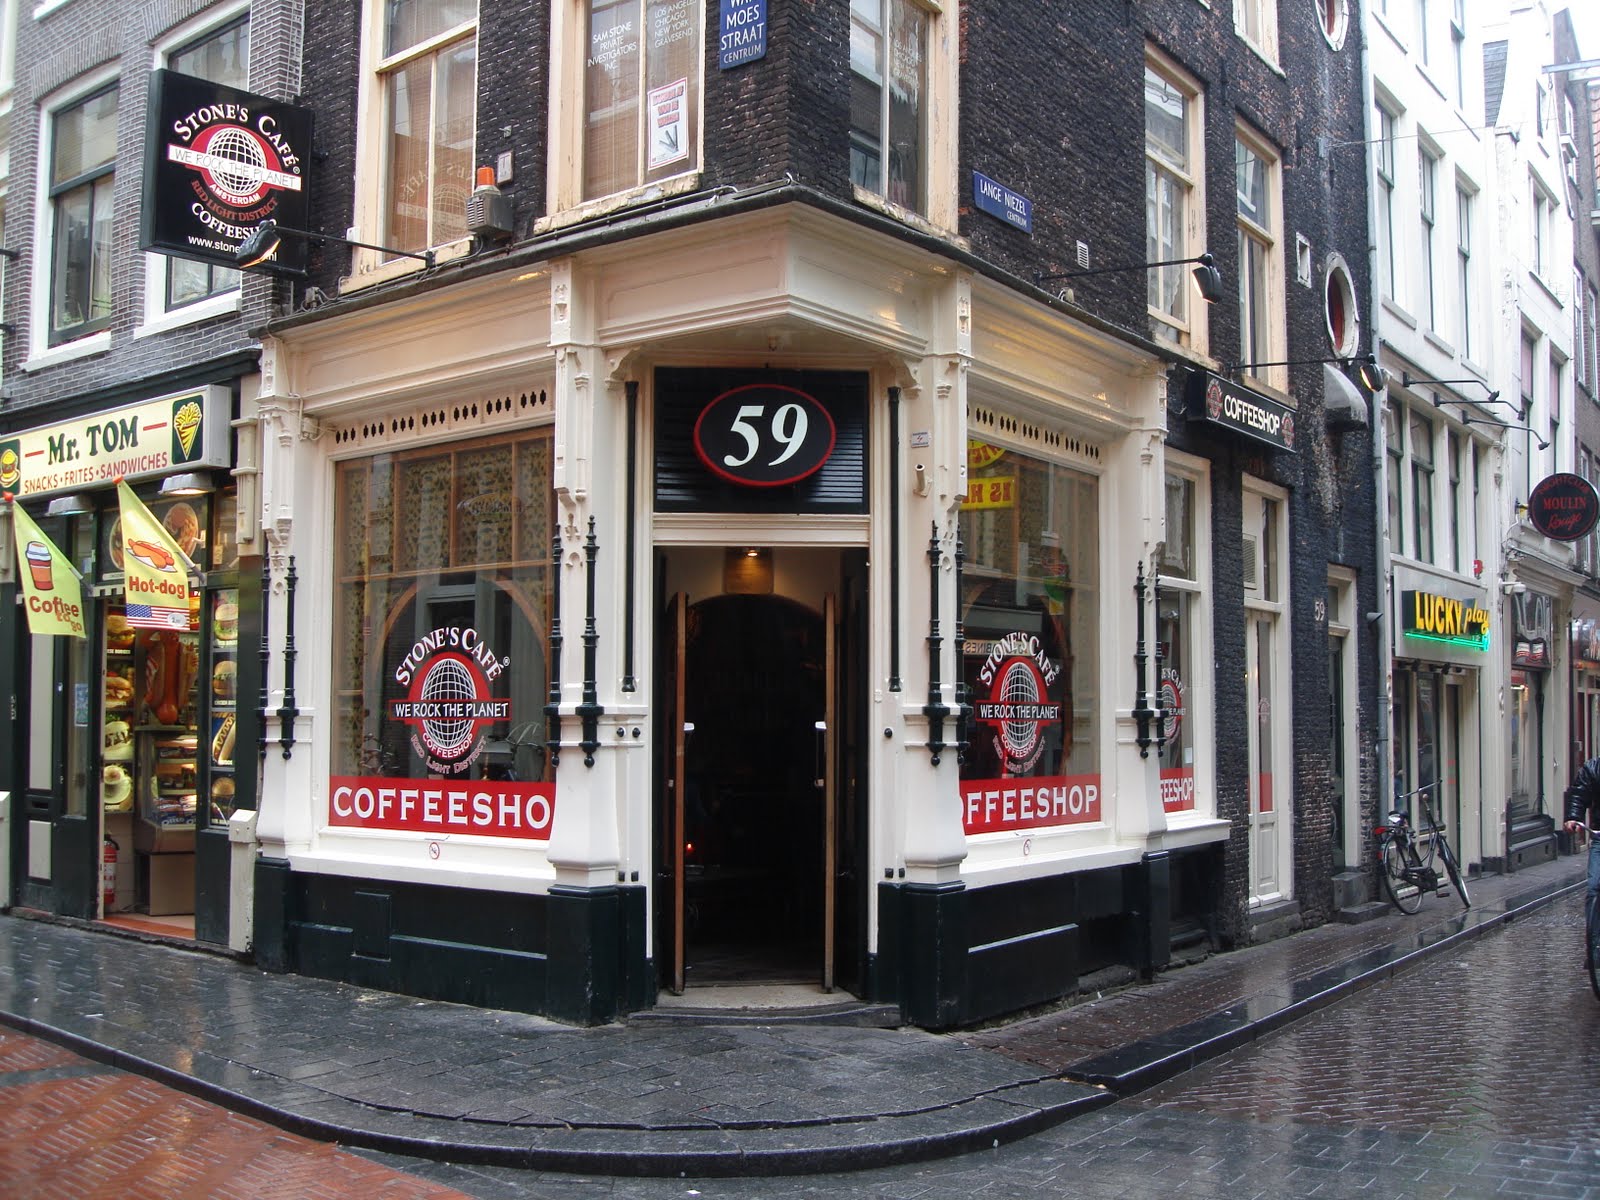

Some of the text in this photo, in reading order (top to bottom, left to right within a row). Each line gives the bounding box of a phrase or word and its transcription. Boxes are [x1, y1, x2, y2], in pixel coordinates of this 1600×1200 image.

[654, 9, 686, 28] CHICAGO
[655, 7, 667, 19] LOS
[726, 4, 760, 30] MOES
[592, 21, 632, 44] SAM STONE
[654, 18, 690, 38] NEW YORK
[720, 22, 765, 51] STRAAT
[587, 41, 637, 67] INVESTIGATORS
[600, 35, 624, 51] PRIVATE
[723, 43, 762, 64] CENTRUM
[174, 104, 250, 141] STONE'S
[174, 150, 296, 188] WE ROCK THE PLANET
[191, 179, 279, 222] RED LIGHT DISTRICT
[209, 183, 262, 205] AMSTERDAM
[980, 179, 1027, 216] LANGE NIEZEL
[191, 202, 278, 240] COFFEES
[1006, 210, 1028, 228] CENTRUM
[1224, 394, 1280, 436] COFFEESHOP
[47, 415, 139, 466] Mr. TOM
[723, 403, 808, 467] 59
[24, 451, 168, 494] SNACKS FRITES SANDWICHES
[1543, 496, 1587, 510] MOULIN
[128, 576, 186, 599] Hot-dog
[1315, 601, 1325, 621] 59
[1415, 591, 1491, 636] LUCKY play
[70, 620, 83, 632] go
[395, 627, 460, 686] STONE'S
[980, 631, 1028, 686] STONE'S
[395, 703, 509, 718] WE ROCK THE PLANET
[980, 704, 1059, 719] WE ROCK THE PLANET
[422, 732, 474, 758] COFFEESHOP
[426, 755, 451, 774] LIGHT
[453, 735, 487, 774] DISTRICT
[1001, 733, 1037, 758] COFFEESHOP
[333, 785, 551, 830] COFFEESHO
[960, 784, 1098, 825] FFEESHOP
